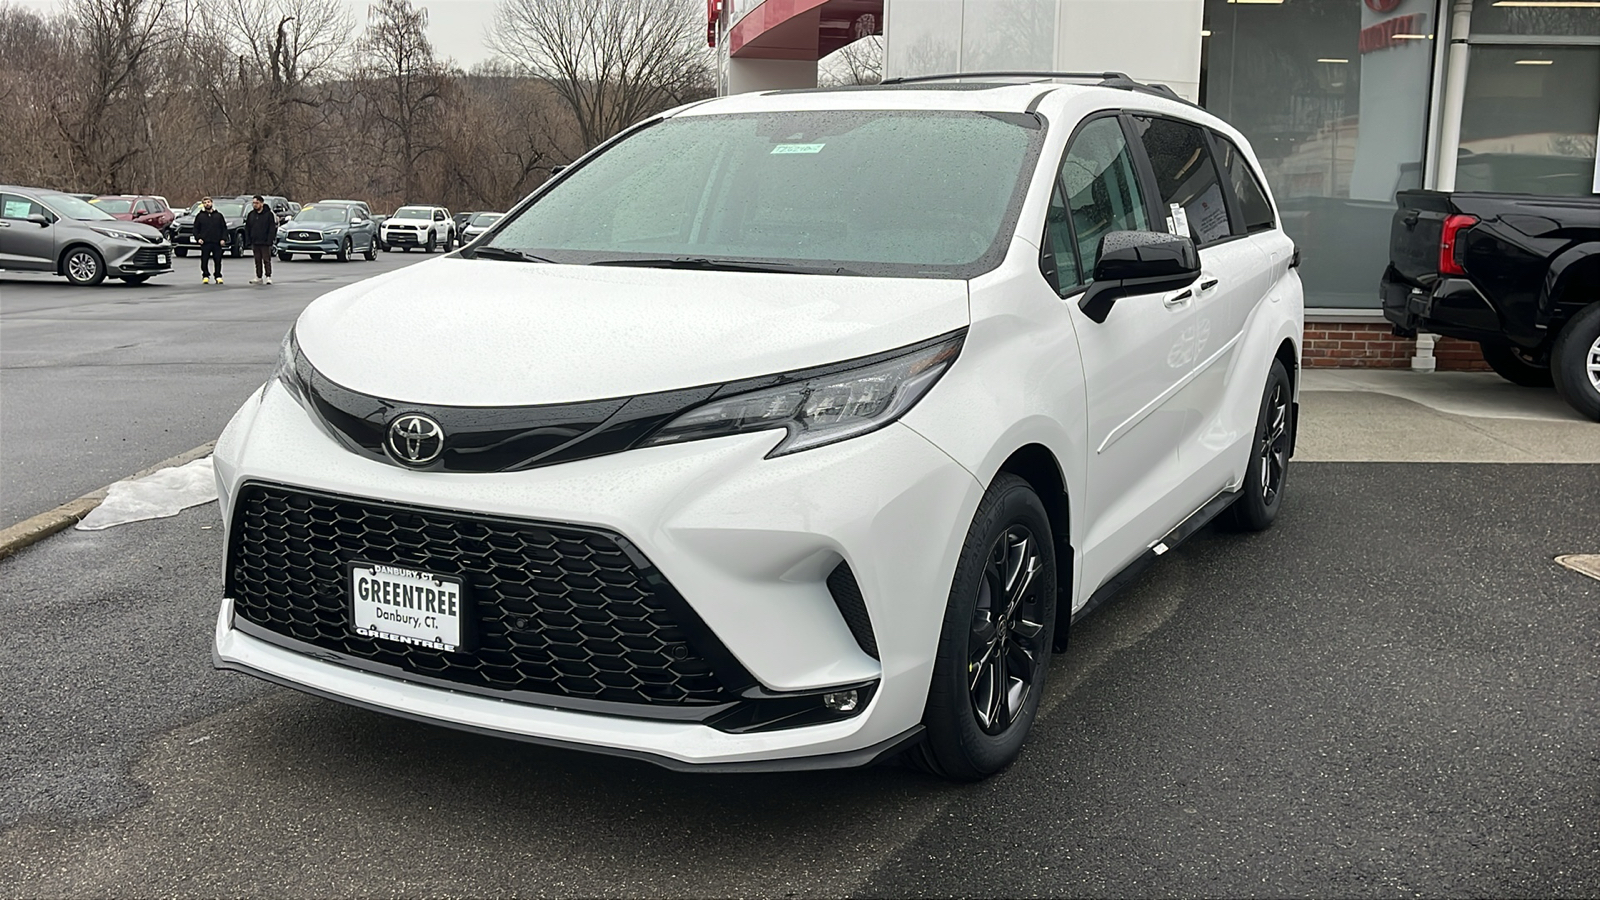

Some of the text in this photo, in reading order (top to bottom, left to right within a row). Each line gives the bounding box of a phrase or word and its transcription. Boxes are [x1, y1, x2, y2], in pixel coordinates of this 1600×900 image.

[358, 577, 457, 617] GREENTREE
[376, 607, 438, 629] Danbury, CT.
[356, 628, 455, 652] GREENTREE
